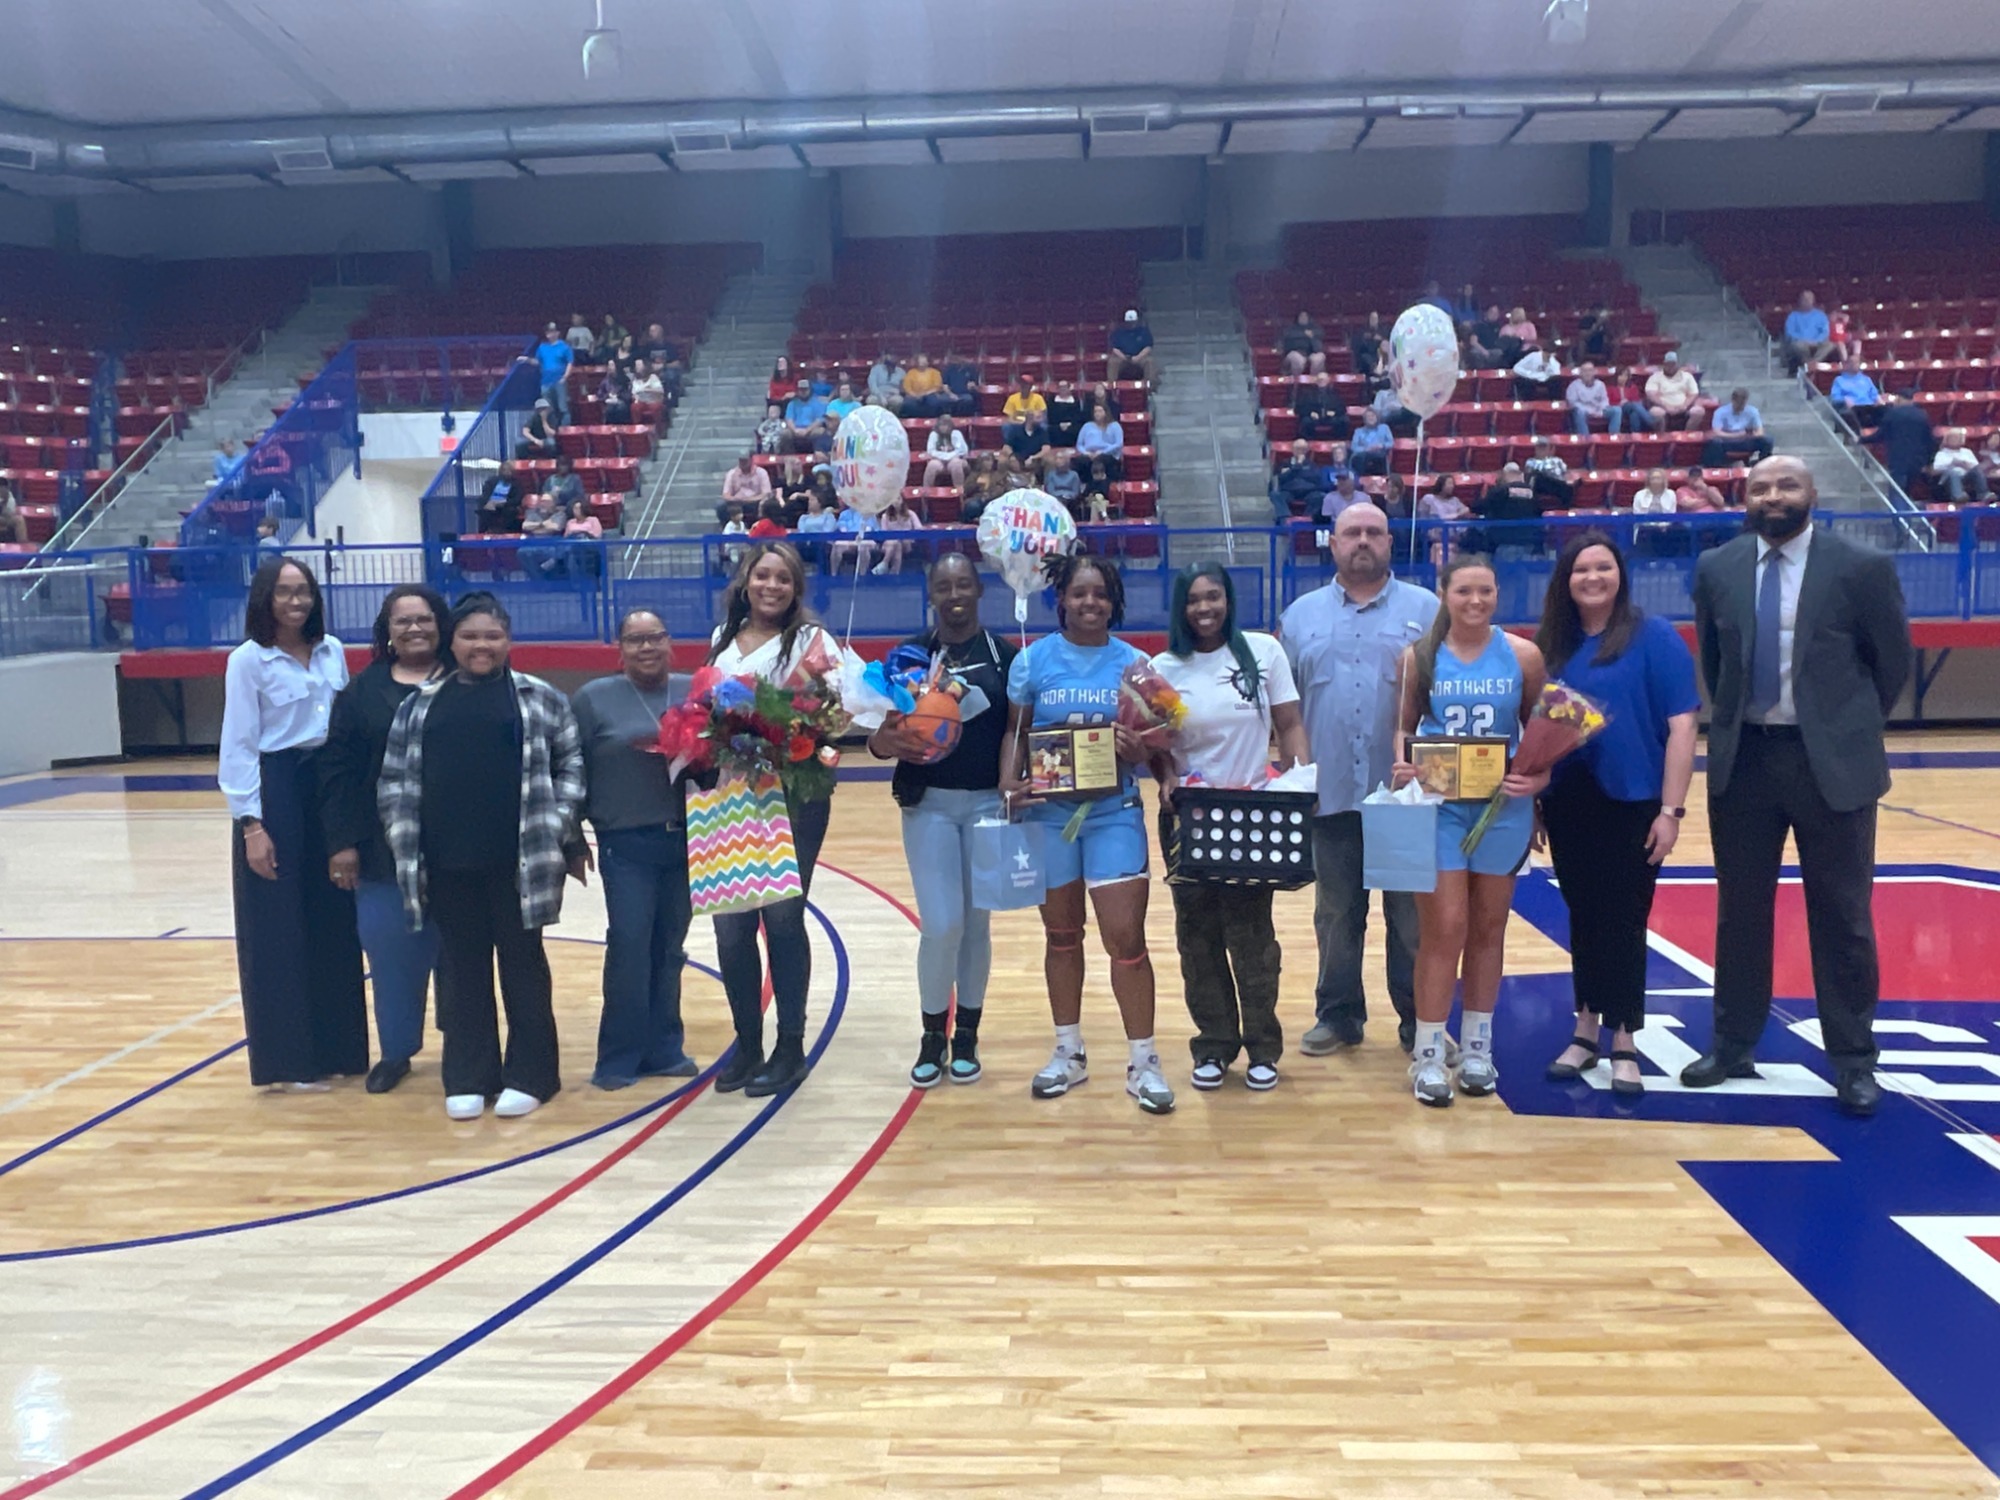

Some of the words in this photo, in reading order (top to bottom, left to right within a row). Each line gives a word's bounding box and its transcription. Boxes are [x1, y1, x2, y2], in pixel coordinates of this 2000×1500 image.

[1429, 678, 1513, 696] ORTHWEST
[1040, 688, 1118, 705] NORTHWES
[1443, 703, 1495, 736] 22
